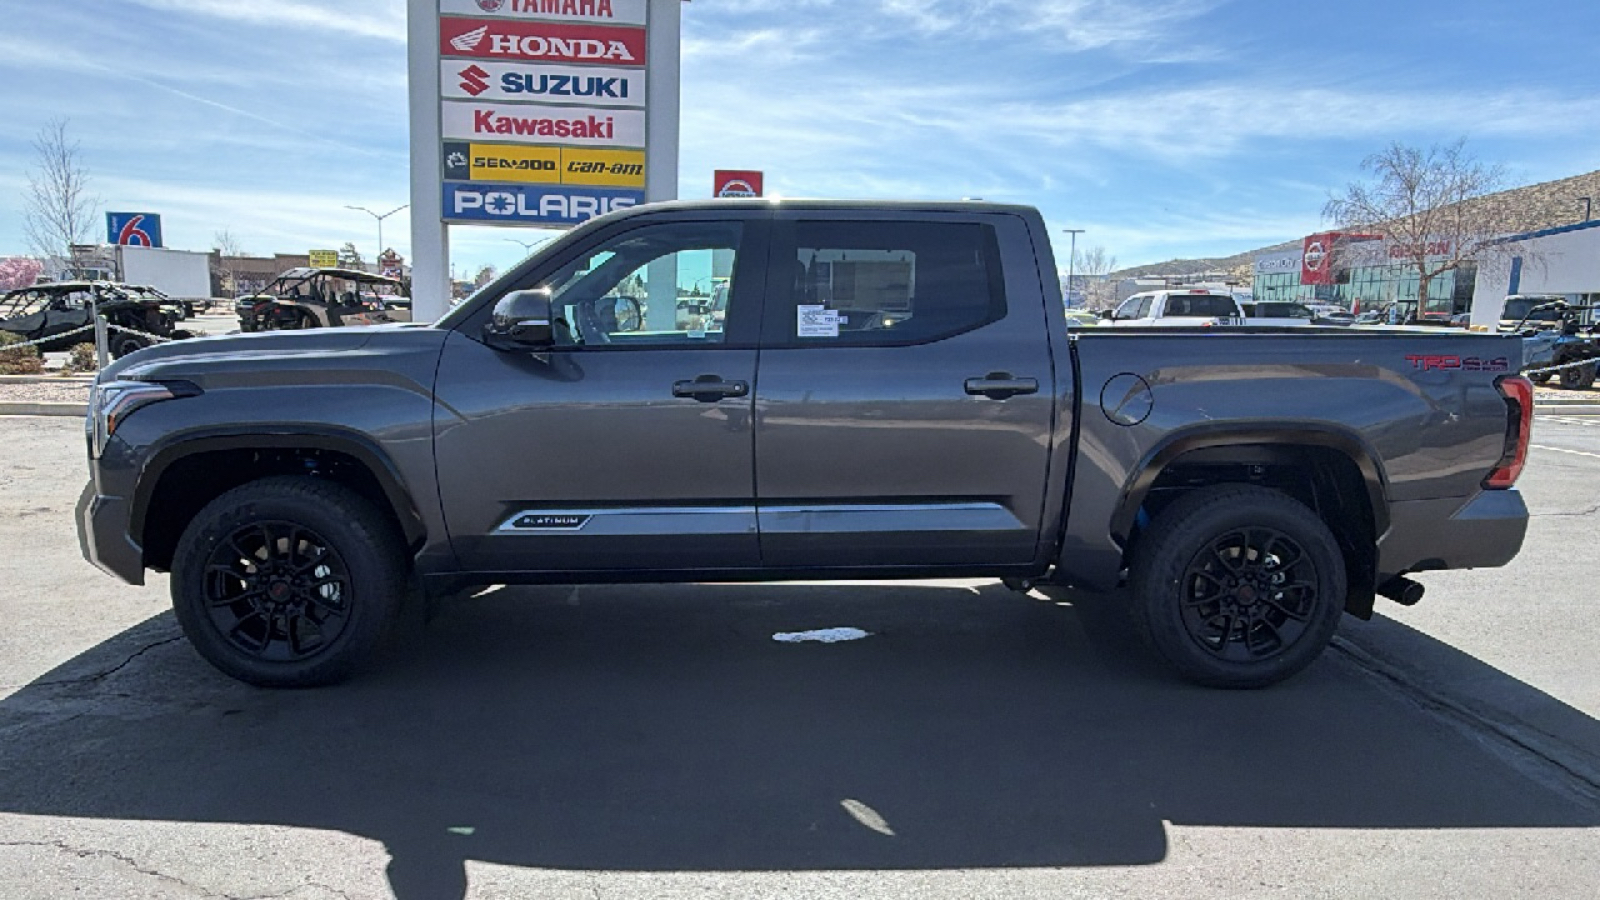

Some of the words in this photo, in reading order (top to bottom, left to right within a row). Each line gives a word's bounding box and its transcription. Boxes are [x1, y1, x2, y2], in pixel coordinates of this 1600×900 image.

[510, 0, 613, 18] YAMAHA
[490, 34, 635, 61] HONDA
[500, 72, 628, 99] SUZUKI
[474, 109, 613, 139] Kawasaki
[119, 214, 152, 248] 6
[1404, 354, 1461, 371] TRD
[523, 516, 578, 524] PLATINUM
